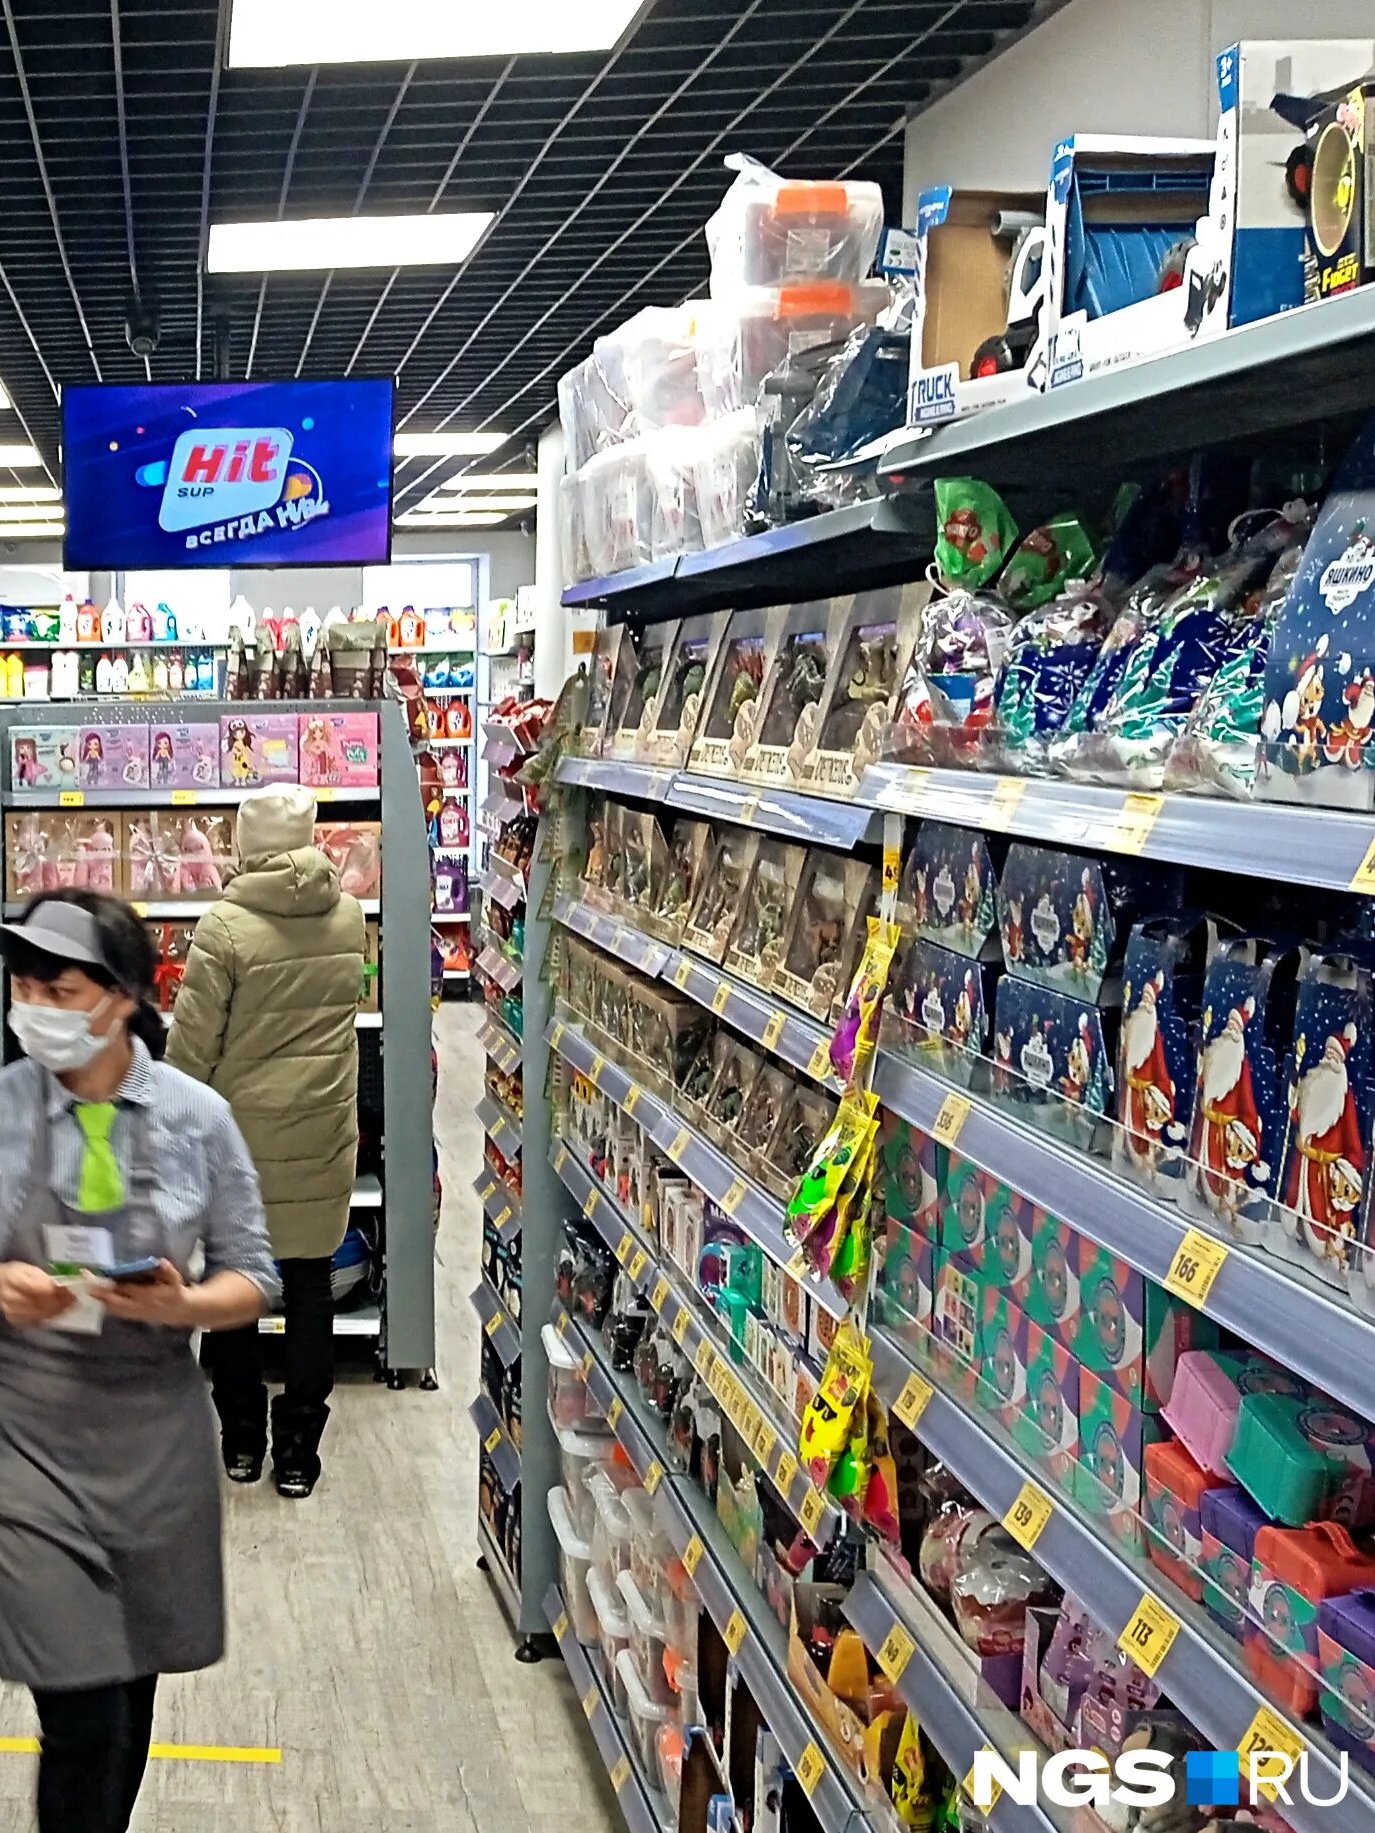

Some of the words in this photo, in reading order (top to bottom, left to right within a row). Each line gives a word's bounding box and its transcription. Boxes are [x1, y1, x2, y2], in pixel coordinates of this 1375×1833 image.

[911, 373, 955, 424] TRUCK
[181, 436, 279, 483] Hit
[177, 486, 215, 498] SUP
[185, 510, 275, 549] ВСЕГДА
[1325, 564, 1373, 586] ЯШКИНО
[1174, 1253, 1200, 1284] 166
[1013, 1500, 1034, 1527] 139
[1130, 1617, 1156, 1648] 113
